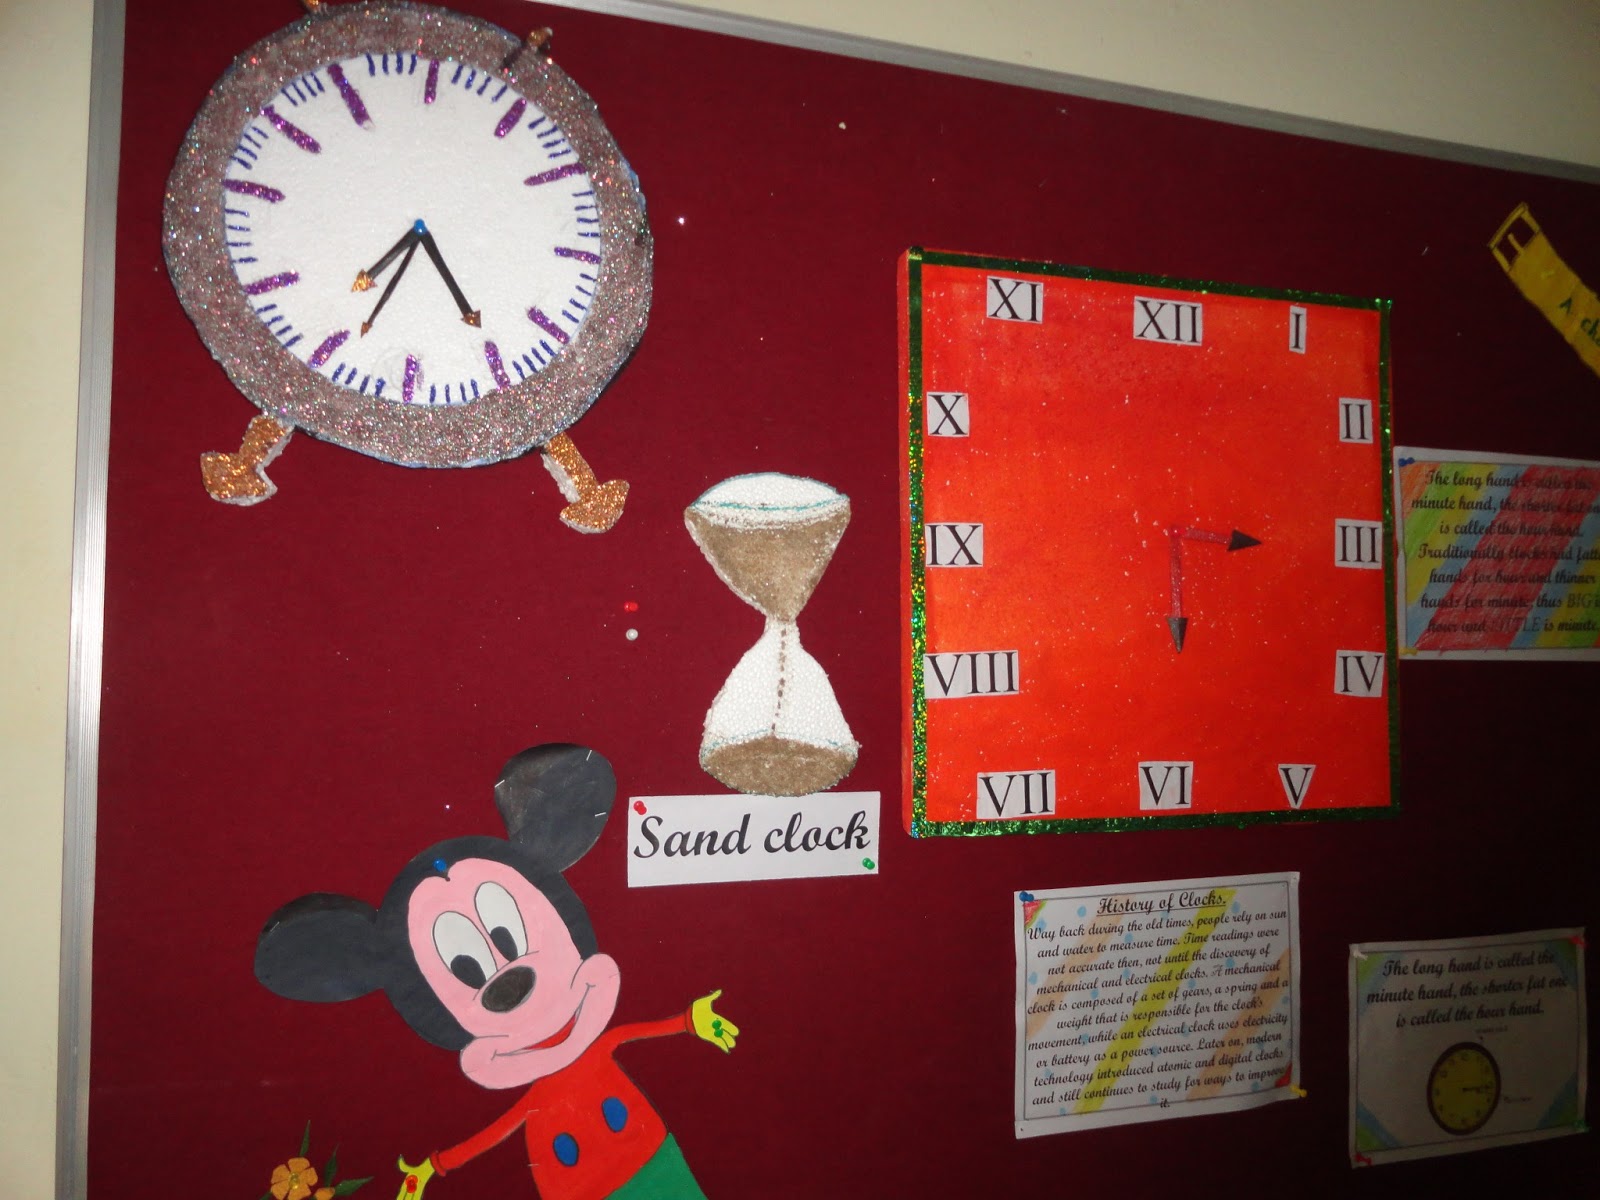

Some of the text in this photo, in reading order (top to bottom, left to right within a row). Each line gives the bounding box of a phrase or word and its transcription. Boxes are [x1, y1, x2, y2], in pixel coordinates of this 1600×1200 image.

[987, 279, 1041, 321] XI
[1137, 301, 1198, 343] XII
[1293, 312, 1303, 349] I
[929, 395, 966, 435] X
[1342, 403, 1369, 440] II
[1425, 470, 1450, 486] The
[1453, 471, 1482, 489] long
[1486, 471, 1519, 486] hand
[1411, 496, 1456, 510] minute
[926, 525, 981, 566] IX
[1338, 525, 1379, 564] III
[1440, 520, 1450, 535] is
[1454, 520, 1496, 535] called
[928, 653, 1017, 697] VIII
[1340, 655, 1382, 692] IV
[980, 773, 1052, 817] VII
[1142, 765, 1189, 806] VI
[1280, 768, 1312, 805] V
[634, 810, 871, 859] Sand clock
[1097, 890, 1226, 916] History of Clocks.
[1028, 910, 1287, 942] Way back during the old times, people rely on sun
[1037, 928, 1280, 958] and water to measure time. Time readings were
[1037, 959, 1280, 995] mechanical and electrical clocks. A mechanical
[1048, 943, 1271, 975] not accurate then, not until the discovery of
[1382, 949, 1555, 978] The long hand is called the
[1027, 1001, 1055, 1015] clock
[1059, 1000, 1067, 1011] is
[1071, 994, 1120, 1011] composed
[1126, 991, 1138, 1006] of
[1151, 991, 1165, 1000] set
[1168, 986, 1179, 1002] of
[1182, 986, 1212, 1000] gears,
[1215, 986, 1222, 994] a
[1225, 981, 1257, 996] spring
[1261, 977, 1280, 989] and
[1366, 975, 1568, 1004] minute hand, the shorter fat one
[1056, 1015, 1092, 1031] weight
[1095, 1012, 1117, 1024] that
[1120, 1011, 1128, 1021] is
[1133, 1006, 1191, 1022] responsible
[1194, 998, 1211, 1017] for
[1213, 1000, 1229, 1012] the
[1088, 1030, 1118, 1043] while
[1120, 1031, 1134, 1040] an
[1137, 1022, 1185, 1039] electrical
[1188, 1019, 1215, 1033] clock
[1218, 1020, 1239, 1030] uses
[1242, 1013, 1288, 1028] electricity
[1396, 1000, 1545, 1029] is called the hour hand.
[1034, 1046, 1283, 1087] technology introduced atomic and digital clocks
[1036, 1058, 1048, 1068] or
[1051, 1052, 1090, 1067] battery
[1094, 1052, 1106, 1061] as
[1110, 1051, 1118, 1059] a
[1121, 1047, 1154, 1062] power
[1158, 1042, 1194, 1054] source.
[1197, 1035, 1225, 1050] Later
[1246, 1031, 1282, 1045] modern
[1032, 1091, 1055, 1105] and
[1058, 1087, 1081, 1102] still
[1084, 1085, 1134, 1099] continues
[1137, 1083, 1148, 1093] to
[1151, 1077, 1181, 1091] study
[1185, 1076, 1201, 1091] for
[1203, 1076, 1232, 1089] ways
[1235, 1071, 1245, 1082] to
